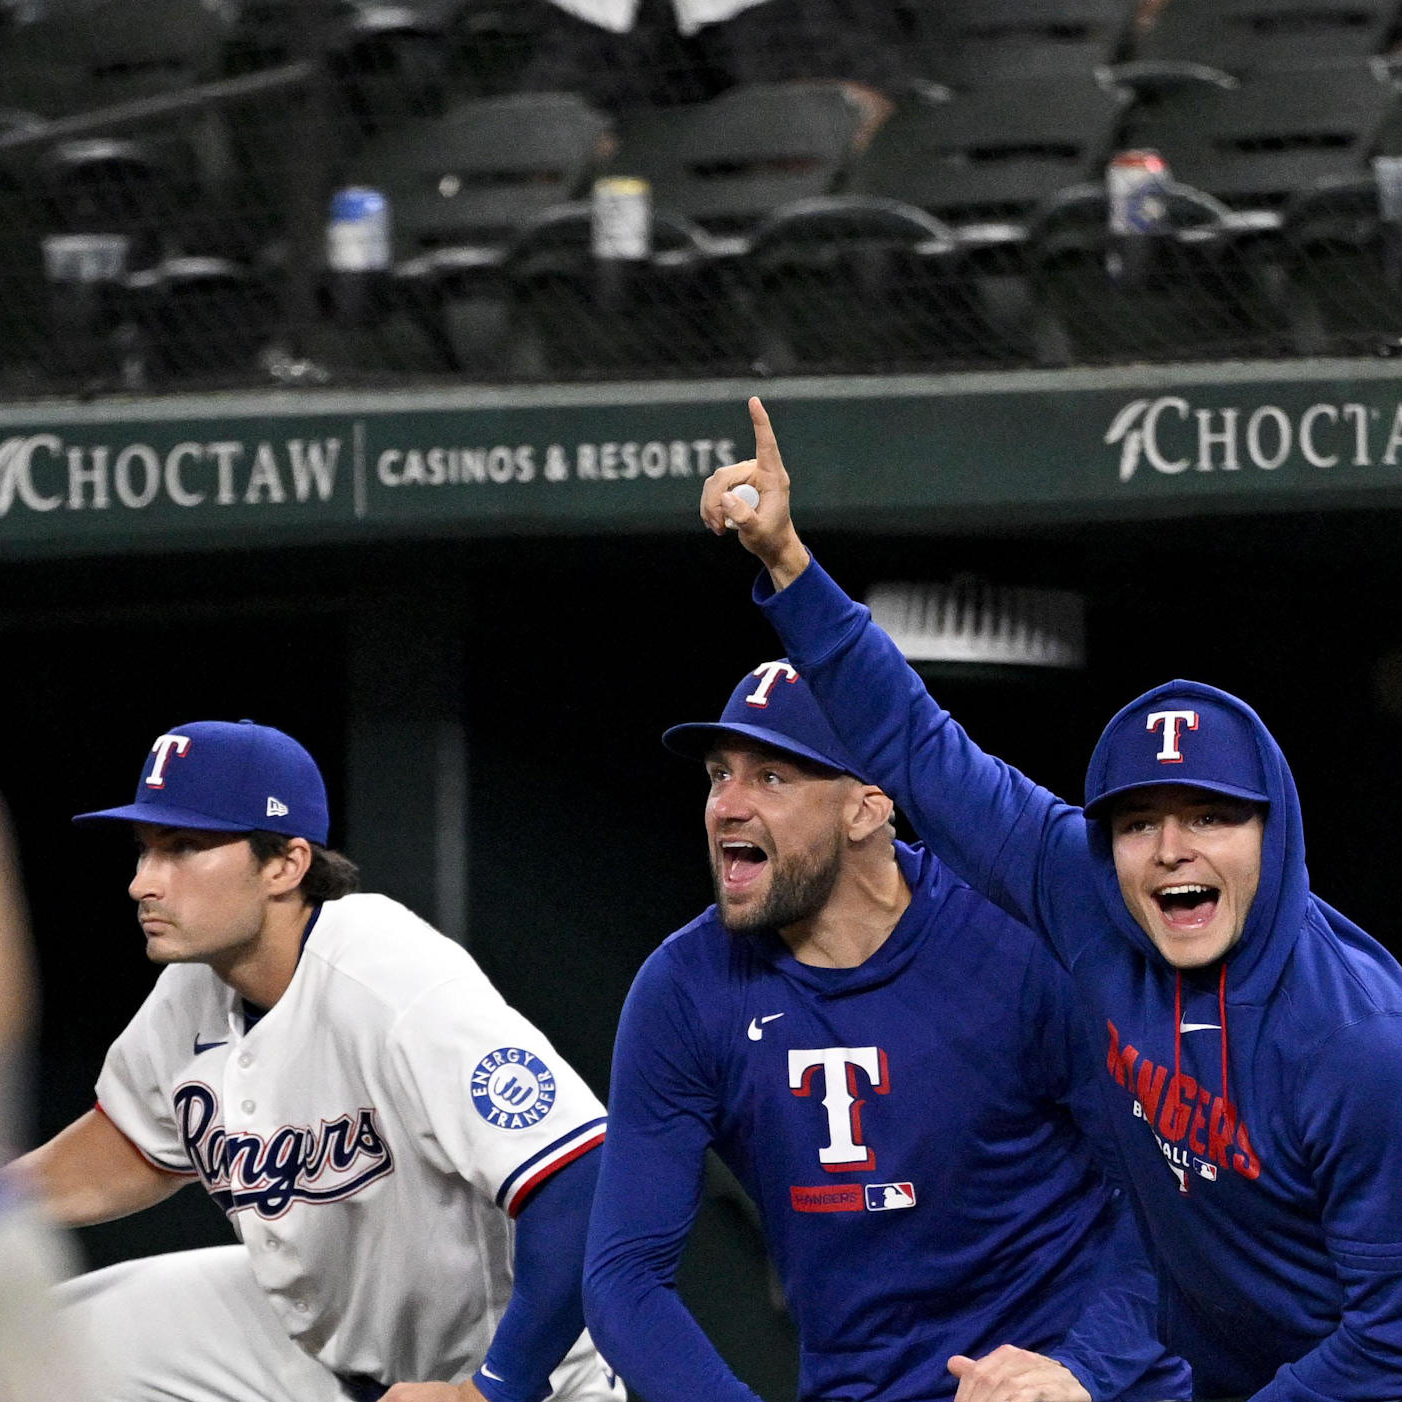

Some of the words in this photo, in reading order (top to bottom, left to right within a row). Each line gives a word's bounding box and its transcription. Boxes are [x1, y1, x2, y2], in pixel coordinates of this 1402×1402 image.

[20, 434, 342, 512] CHOCTAW
[378, 445, 536, 486] CASINOS
[544, 445, 568, 481] &
[577, 438, 736, 480] RESORTS
[745, 661, 800, 709] T
[145, 734, 193, 790] T
[1146, 710, 1200, 764] T
[472, 1048, 535, 1097] ENERGY
[486, 1070, 556, 1128] TRANSFER
[788, 1047, 891, 1173] T
[172, 1081, 396, 1222] Rangers
